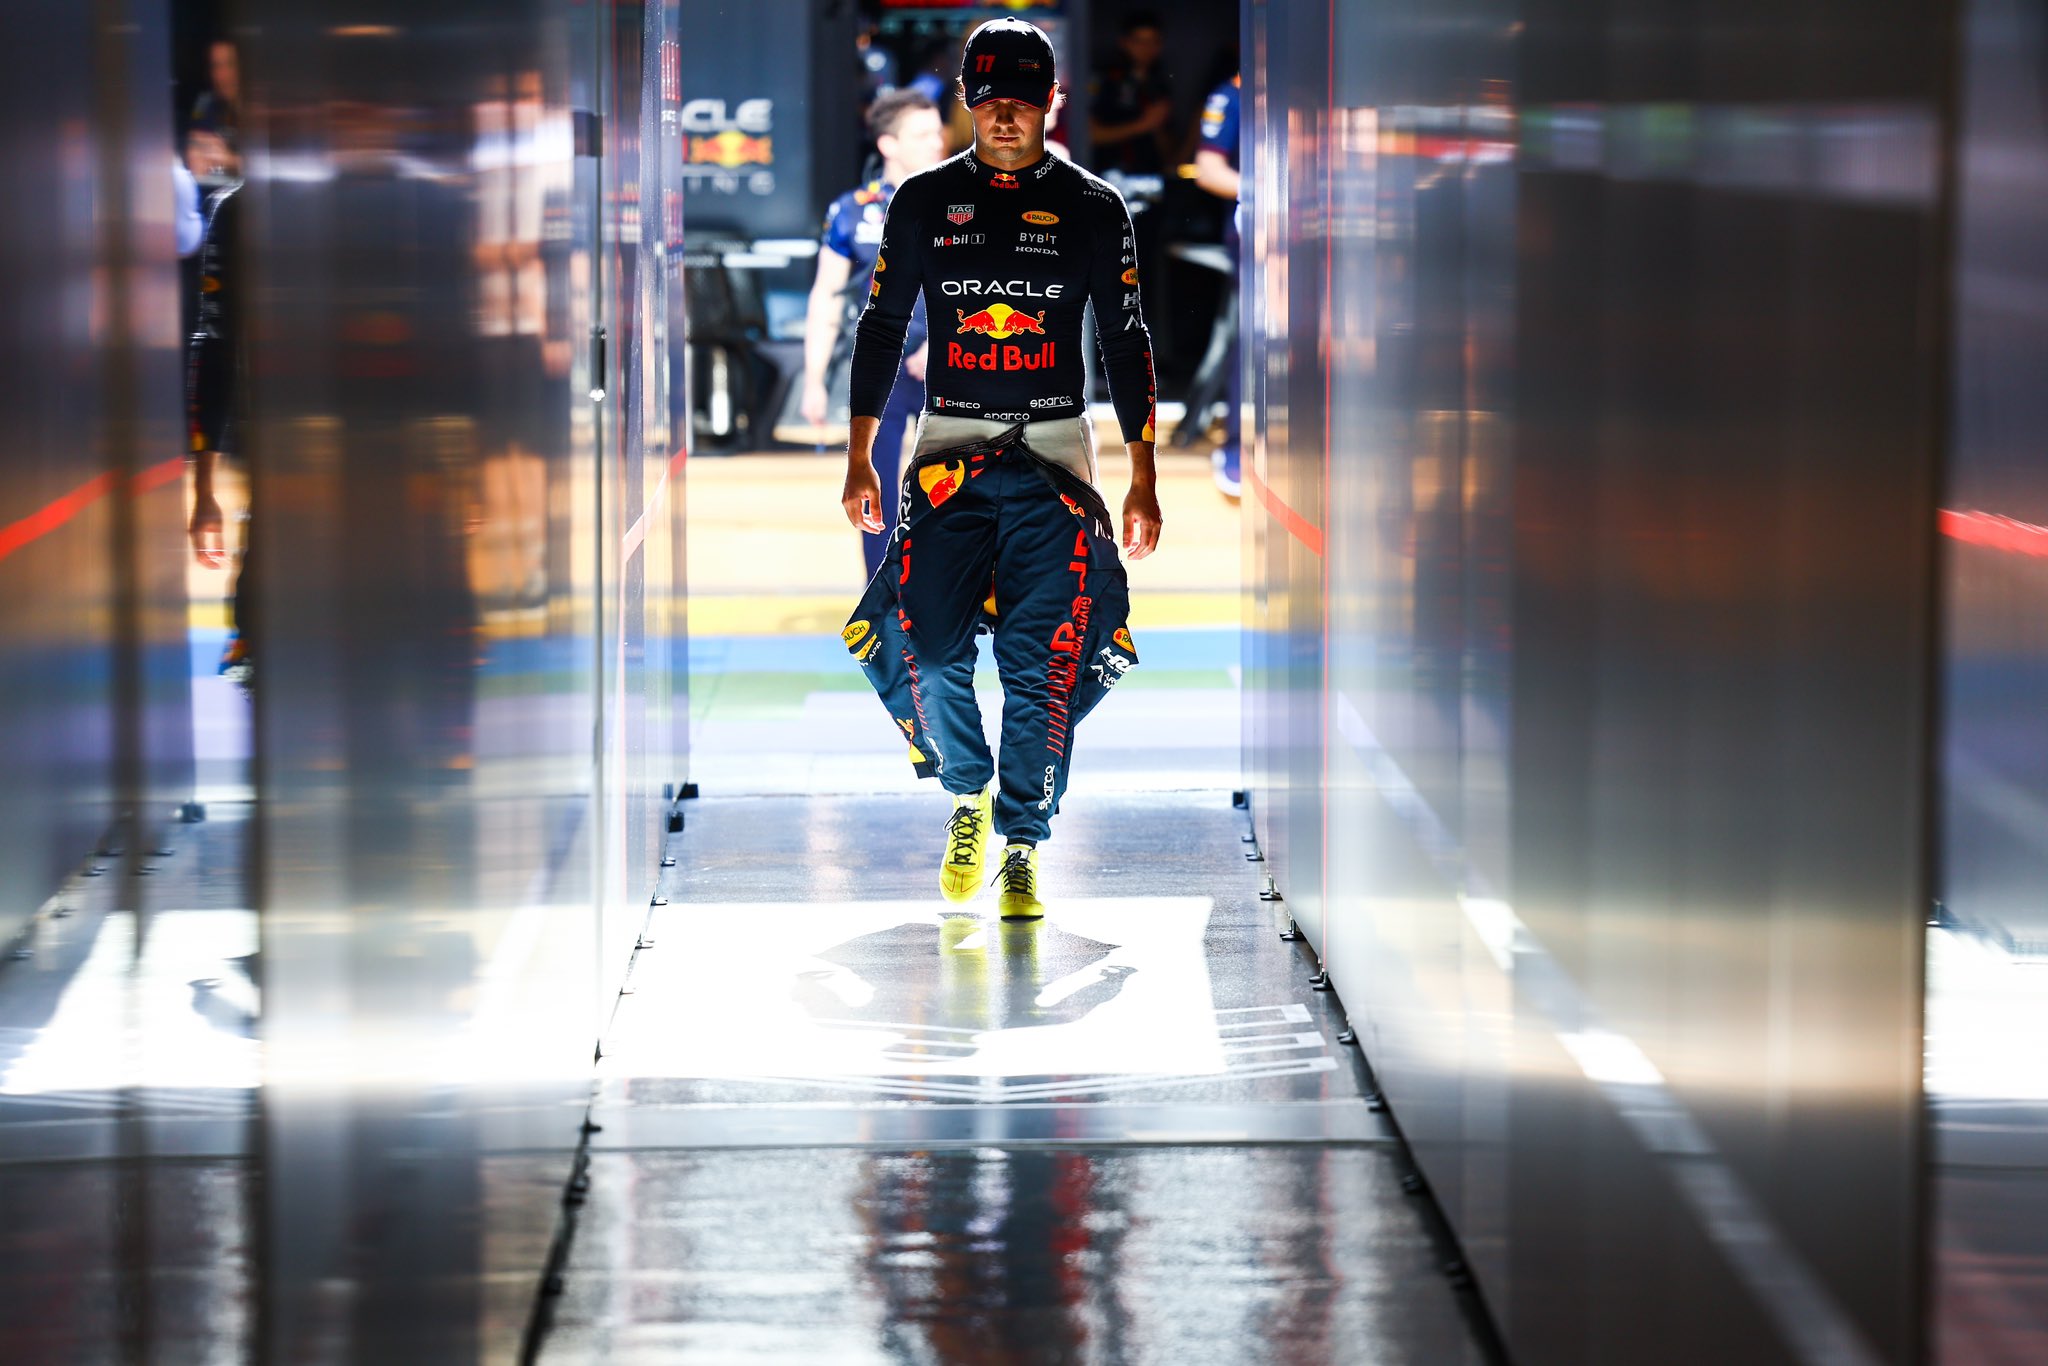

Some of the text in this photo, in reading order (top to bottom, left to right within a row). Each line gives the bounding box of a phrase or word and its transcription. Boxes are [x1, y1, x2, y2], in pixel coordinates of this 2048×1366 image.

[976, 54, 995, 73] 11
[990, 179, 1020, 189] Red Bull
[948, 213, 972, 223] HEUER
[1031, 213, 1055, 223] RAUCH
[934, 234, 968, 247] Mobil
[1019, 232, 1057, 244] BYBIT
[1015, 246, 1059, 256] HONDA
[941, 279, 1065, 298] ORACLE
[948, 341, 1056, 371] Red Bull
[945, 399, 981, 409] CHECO
[1030, 395, 1074, 409] sparco
